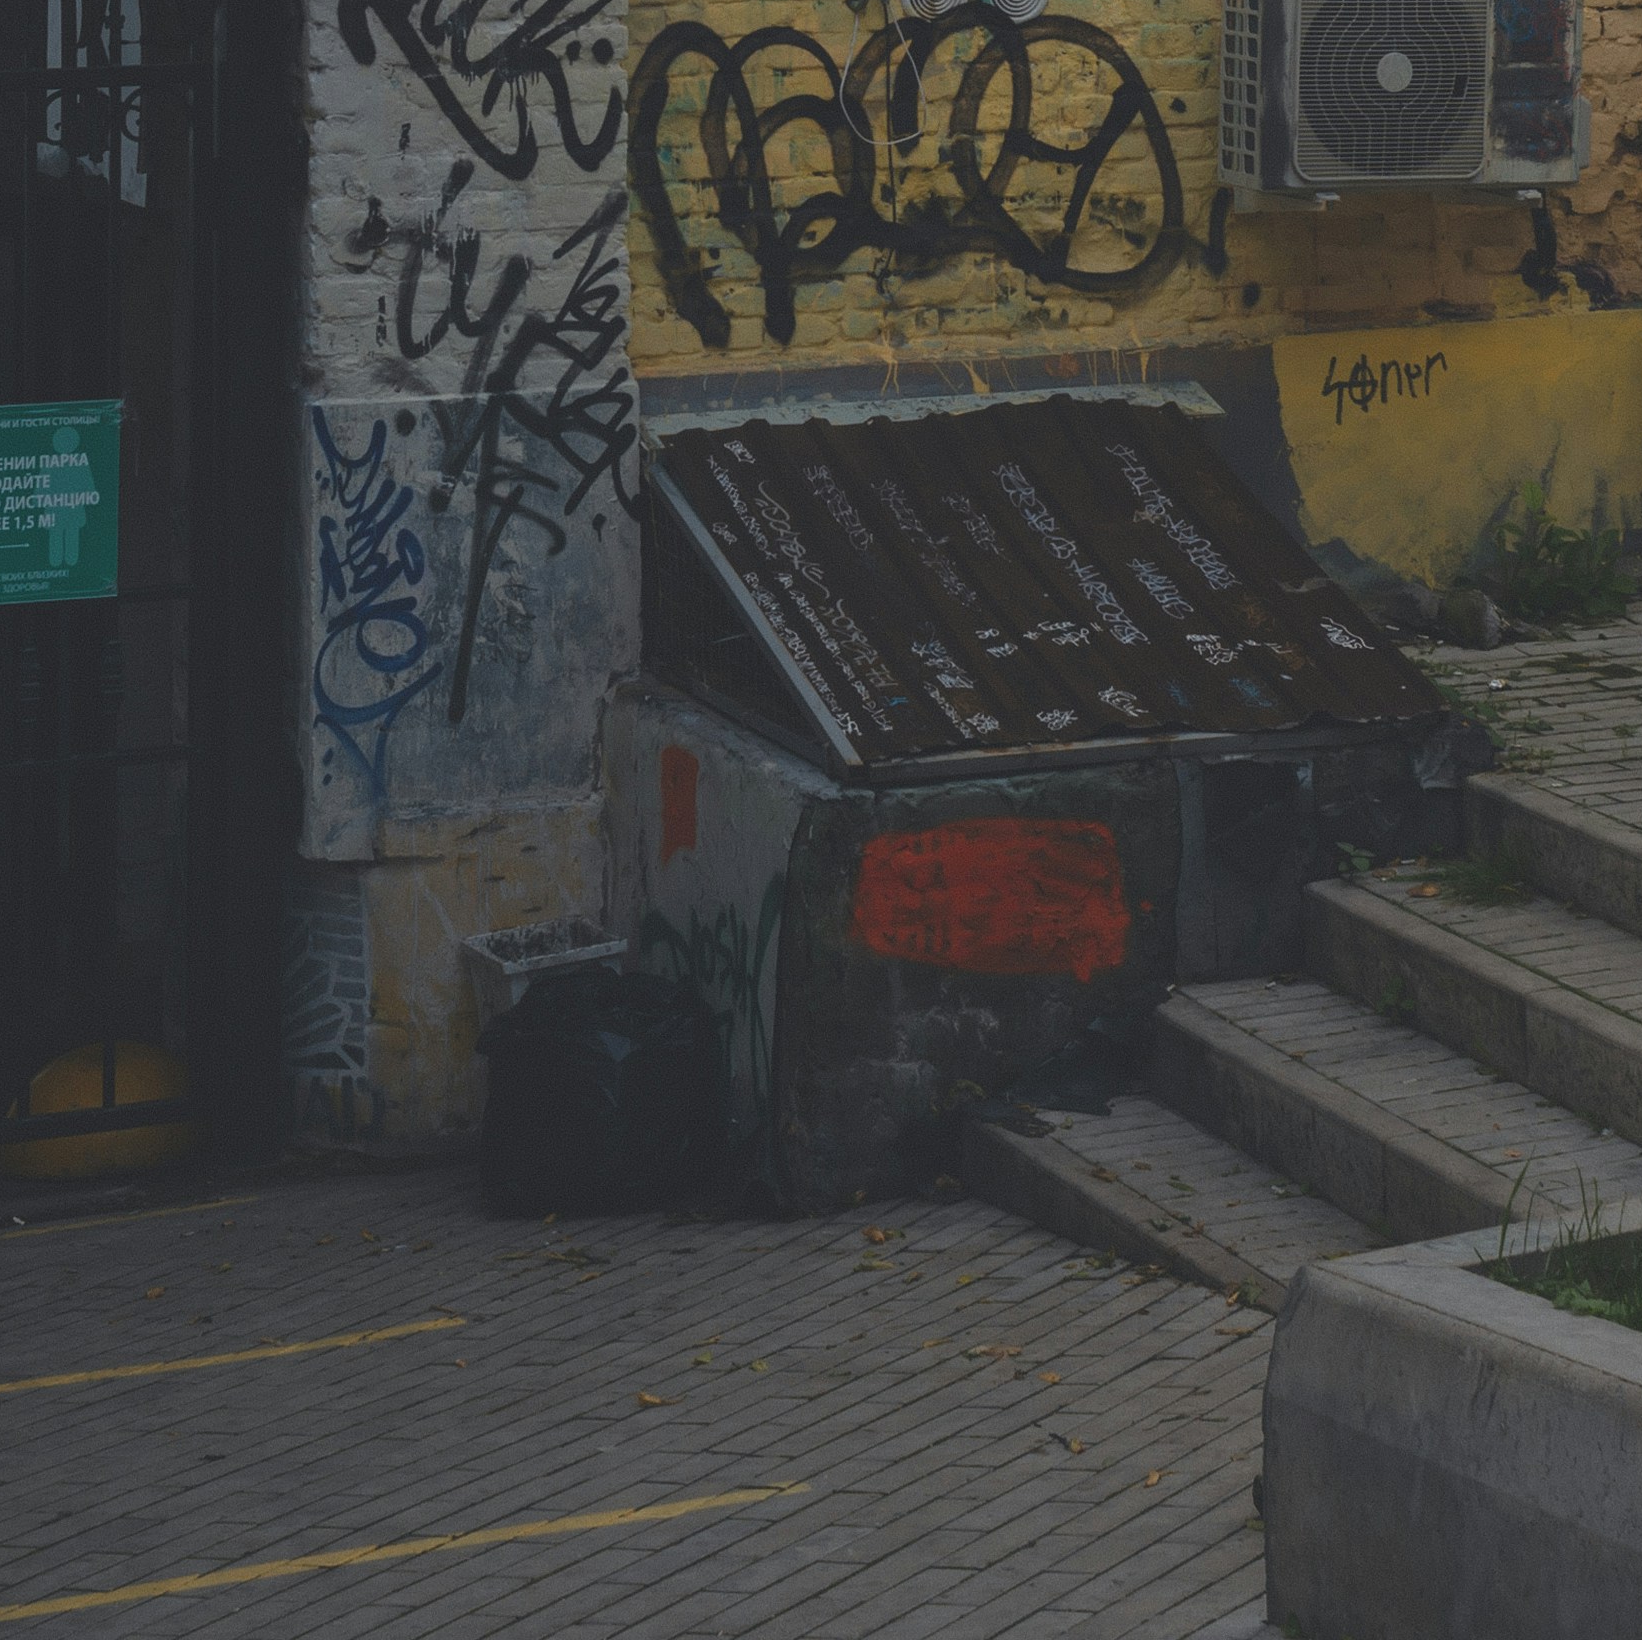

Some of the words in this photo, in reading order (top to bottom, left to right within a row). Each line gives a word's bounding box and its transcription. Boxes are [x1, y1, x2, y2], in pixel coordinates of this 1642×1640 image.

[11, 419, 20, 428] И
[21, 418, 50, 428] ГОСТИ
[52, 415, 100, 427] СТОЛИЦЫ!
[39, 453, 89, 469] ПАРКА
[4, 491, 100, 513] ДИСТАНЦИЮ
[13, 515, 35, 531] 1,5
[38, 513, 56, 528] М!
